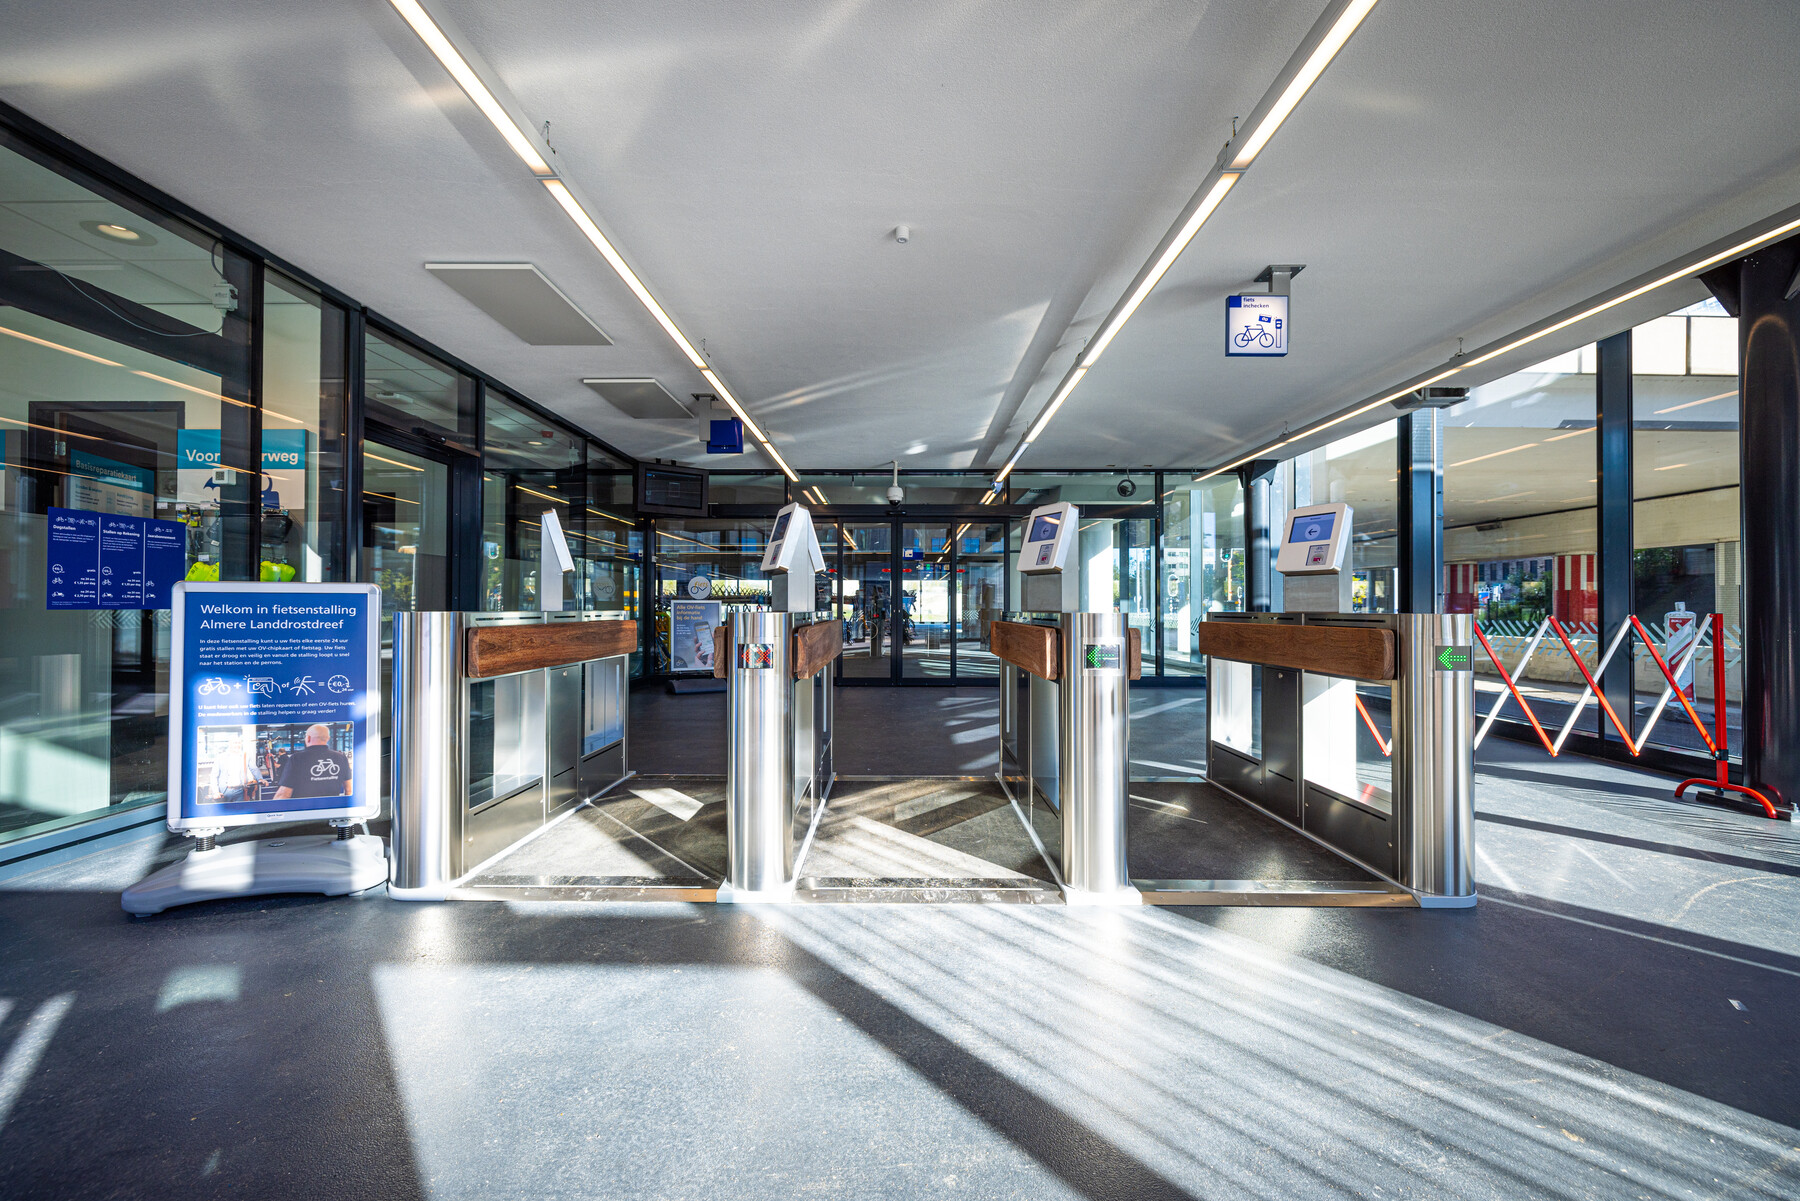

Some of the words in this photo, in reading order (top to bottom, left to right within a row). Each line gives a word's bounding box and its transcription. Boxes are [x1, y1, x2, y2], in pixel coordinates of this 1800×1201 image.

[186, 449, 220, 462] Voor
[262, 452, 298, 465] rweg
[75, 459, 137, 482] Basisreparatiekaart
[200, 604, 253, 615] Welkom
[257, 605, 268, 614] in
[272, 604, 357, 617] fietsenstalling
[200, 620, 246, 629] Almere
[250, 619, 344, 629] Landdrostdreef
